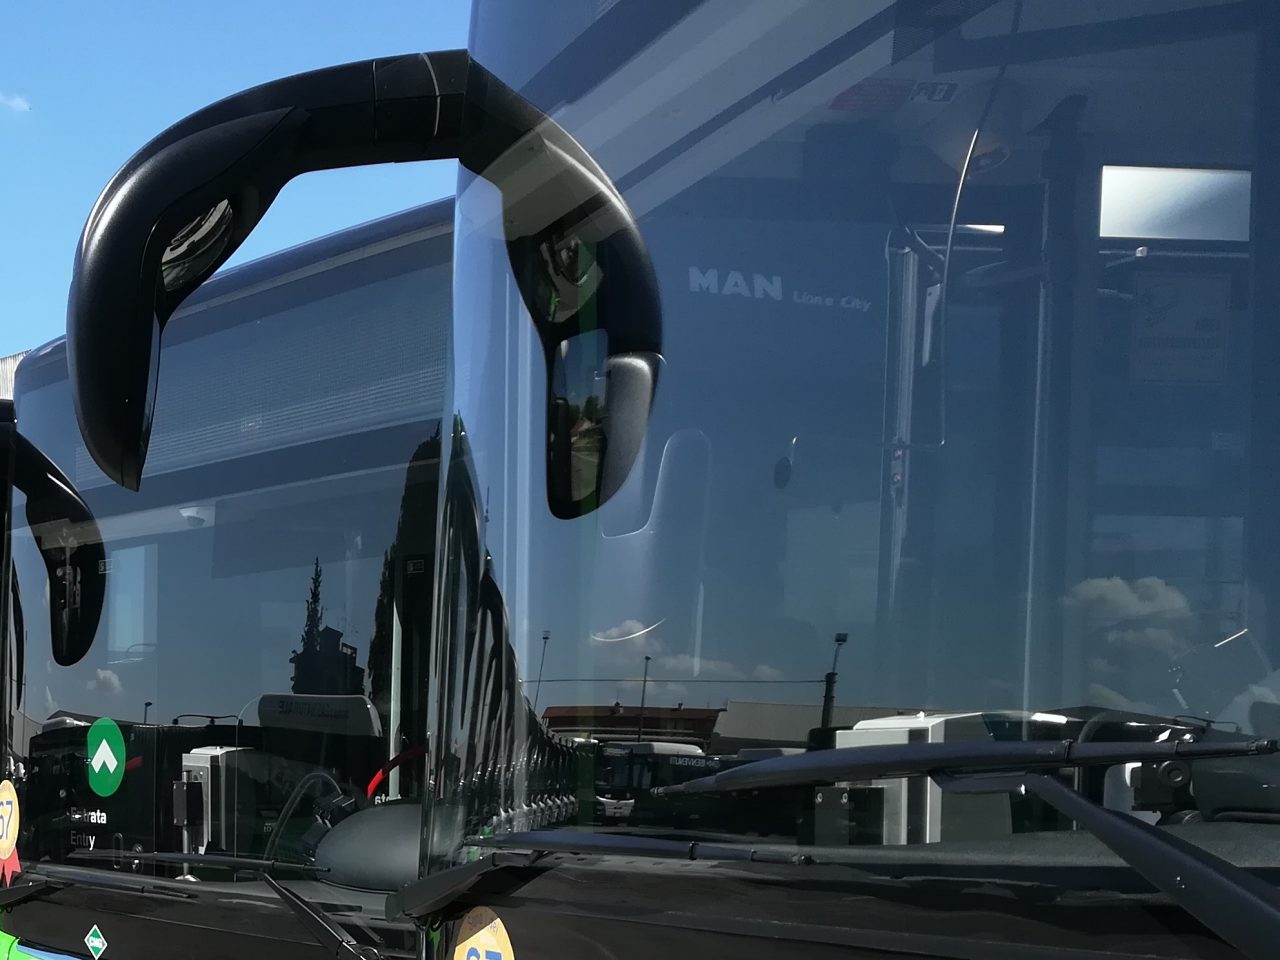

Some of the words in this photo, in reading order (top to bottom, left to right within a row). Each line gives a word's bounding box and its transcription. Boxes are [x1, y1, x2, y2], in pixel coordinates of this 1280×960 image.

[688, 266, 782, 301] MAN
[70, 807, 107, 824] Entrata
[70, 830, 96, 851] Entry
